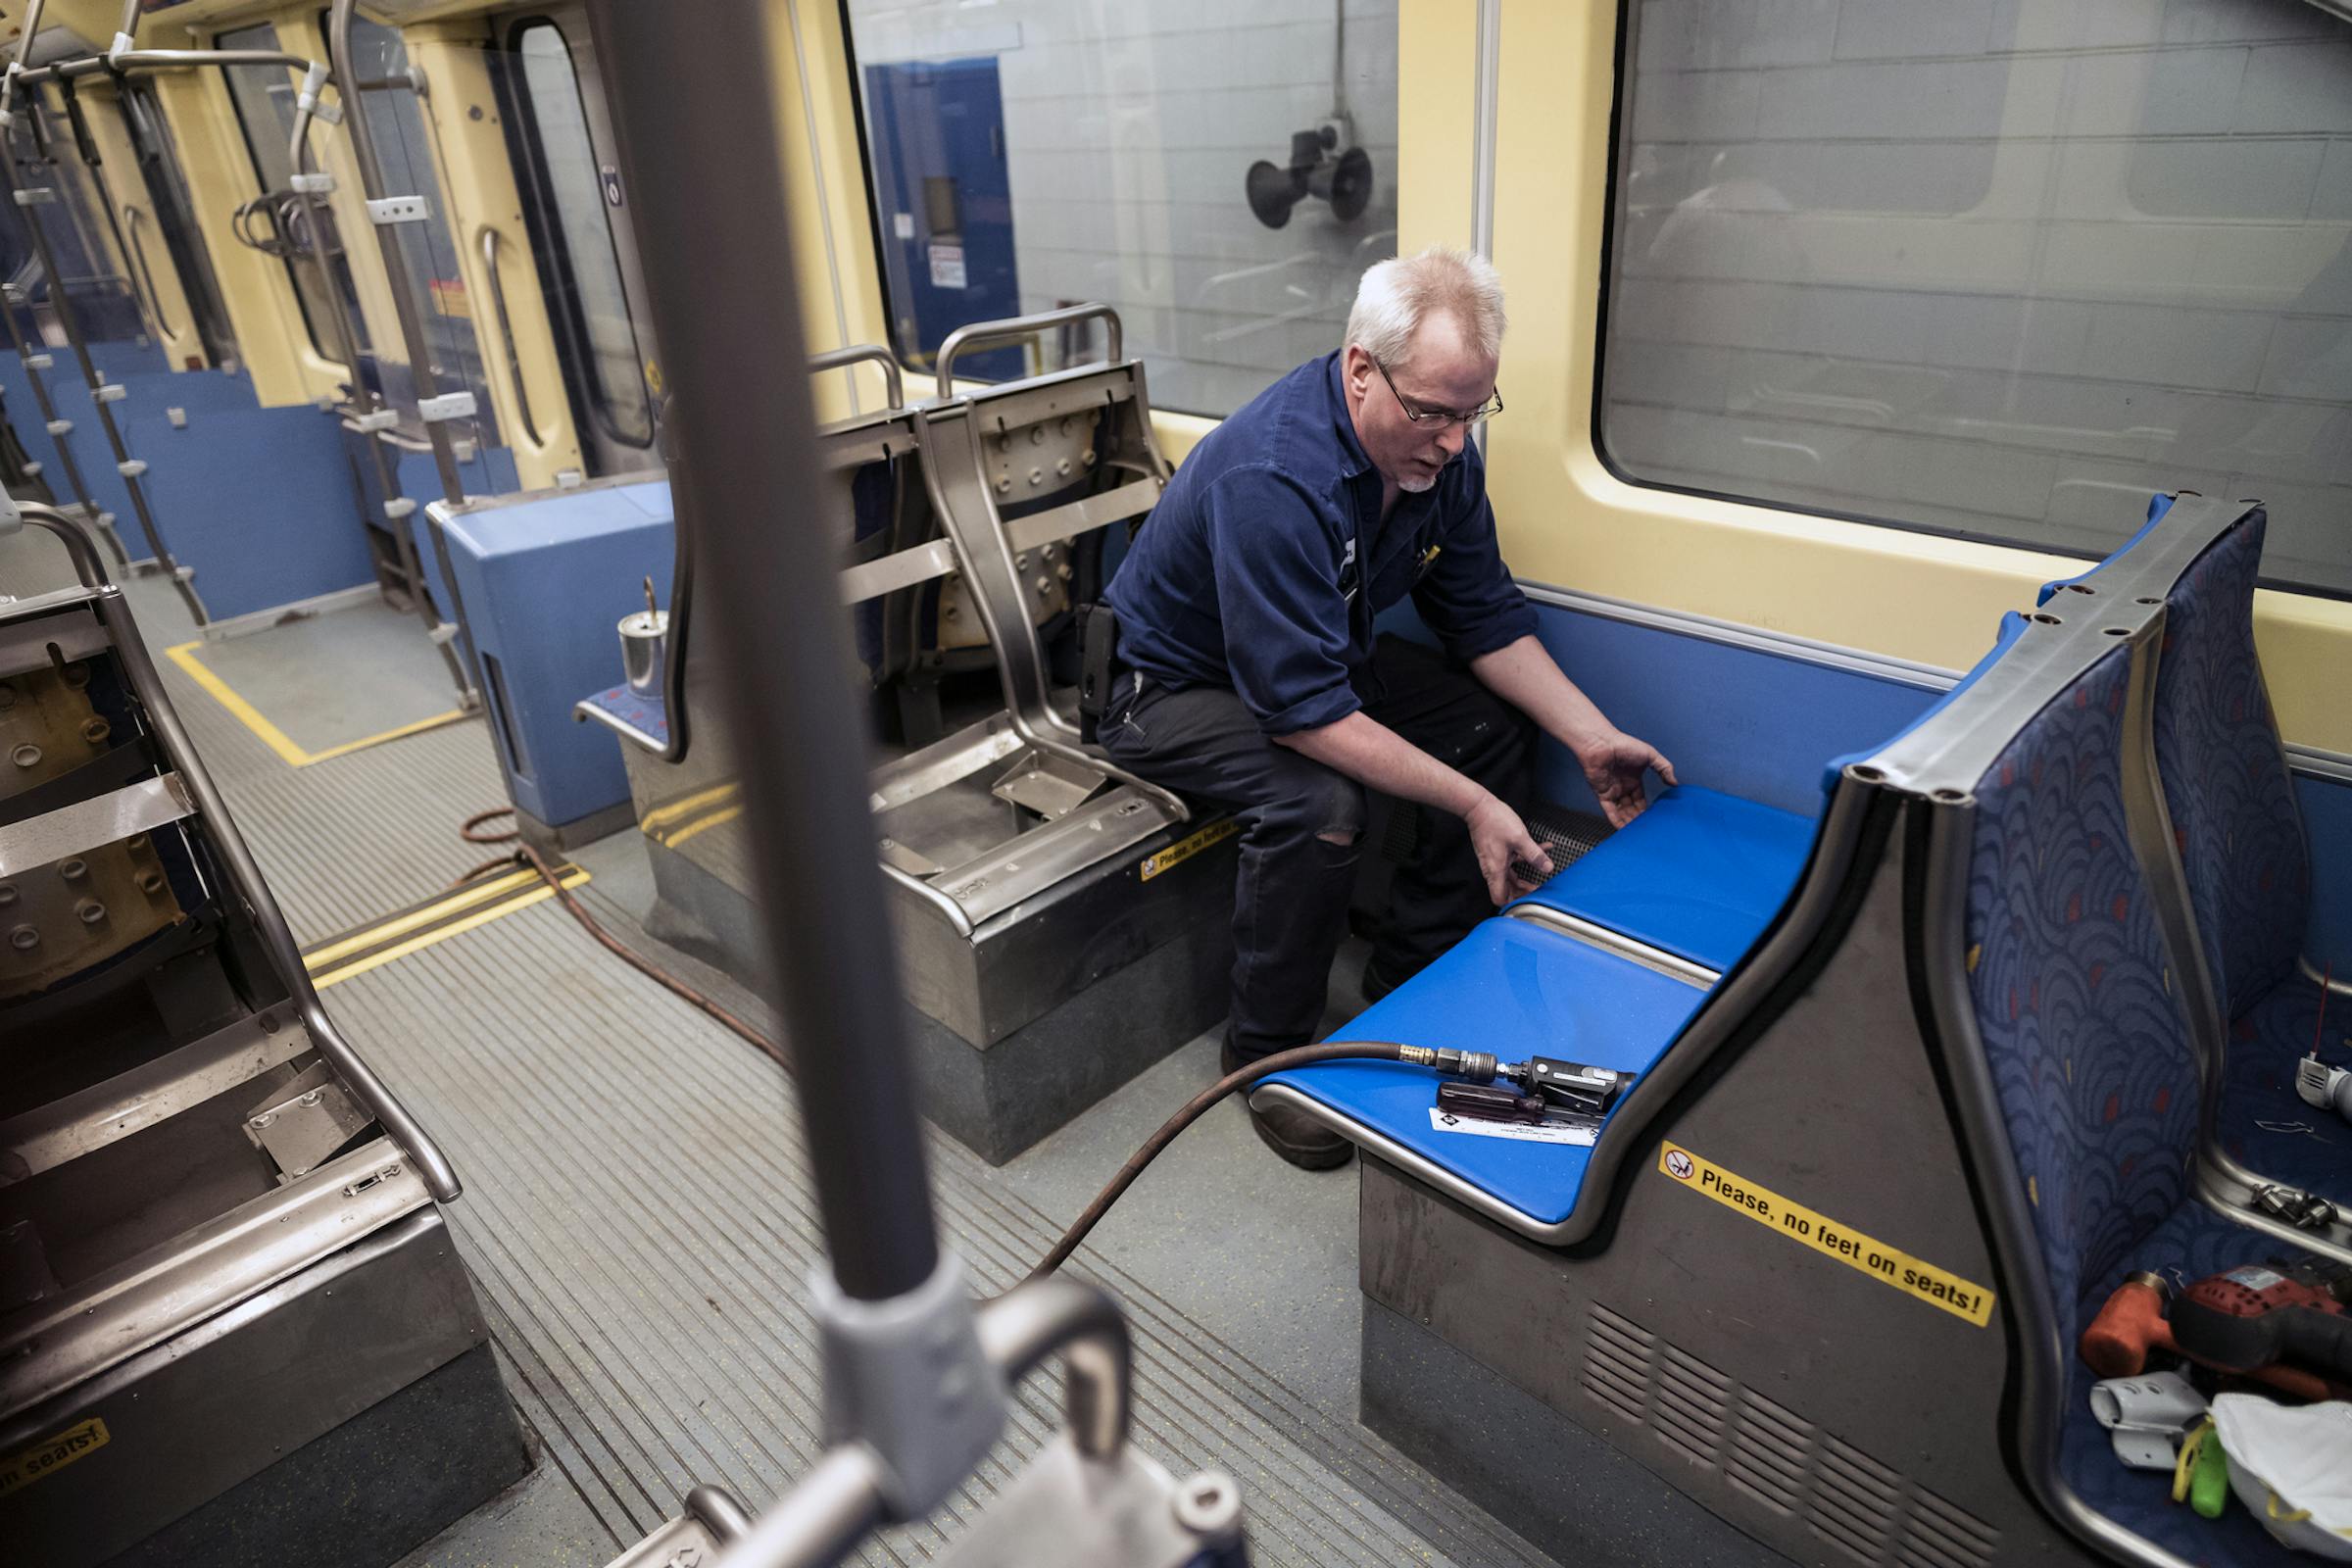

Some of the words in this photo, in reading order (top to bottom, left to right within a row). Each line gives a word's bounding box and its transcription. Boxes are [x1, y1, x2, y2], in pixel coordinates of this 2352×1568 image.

[1700, 1169, 1775, 1221] Please,
[1784, 1211, 1810, 1235] no
[1817, 1225, 1862, 1259] feet
[1867, 1252, 1895, 1276] on
[1903, 1268, 1982, 1314] seats!
[25, 1424, 99, 1474] seats!
